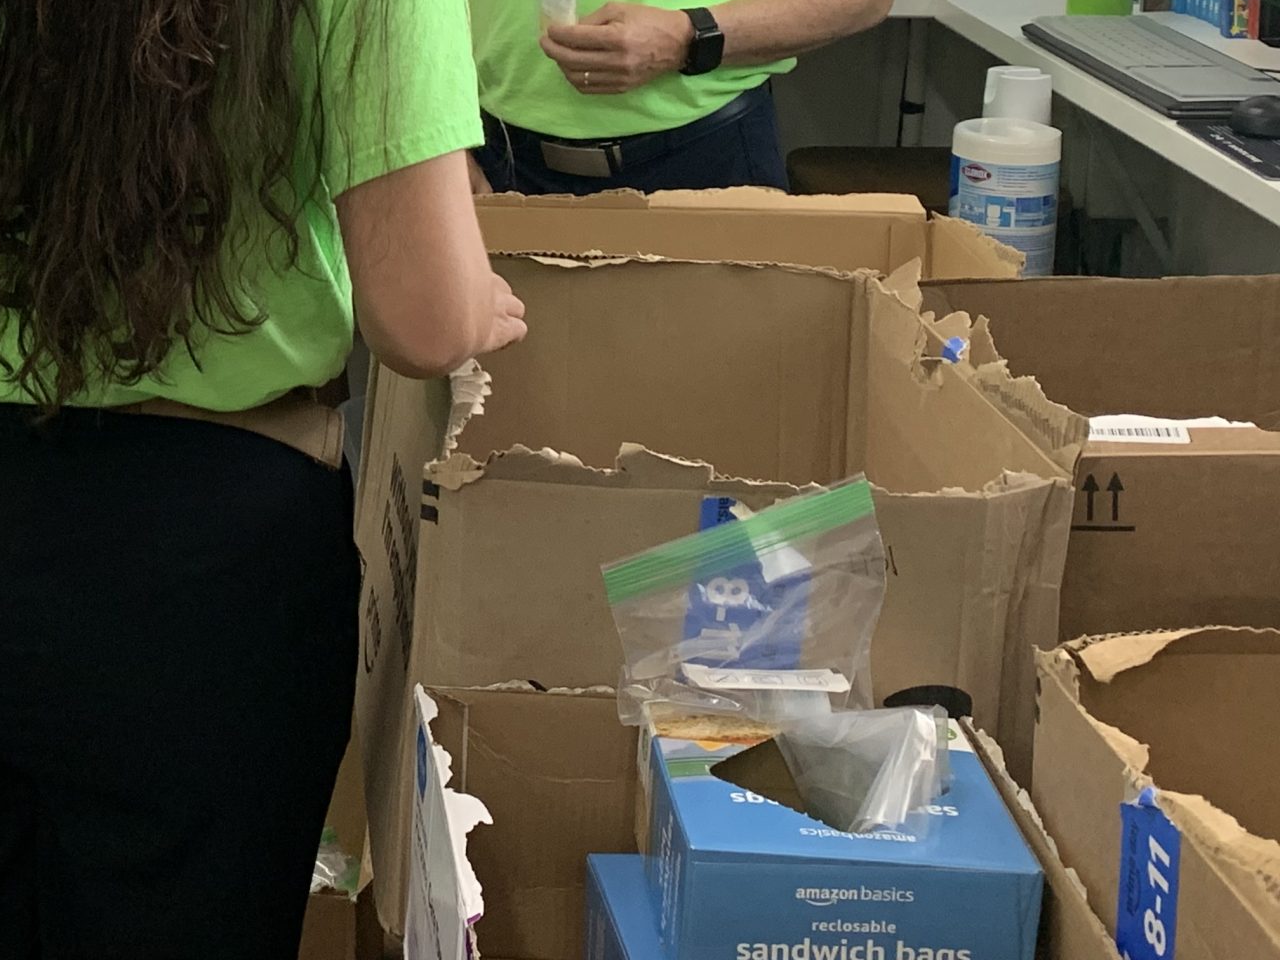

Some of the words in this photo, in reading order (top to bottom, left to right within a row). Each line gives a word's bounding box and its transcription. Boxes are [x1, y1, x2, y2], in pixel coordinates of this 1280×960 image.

[1144, 834, 1170, 956] 8-11
[811, 917, 898, 934] reclosable
[736, 937, 885, 960] sandwich
[896, 940, 972, 960] bags
